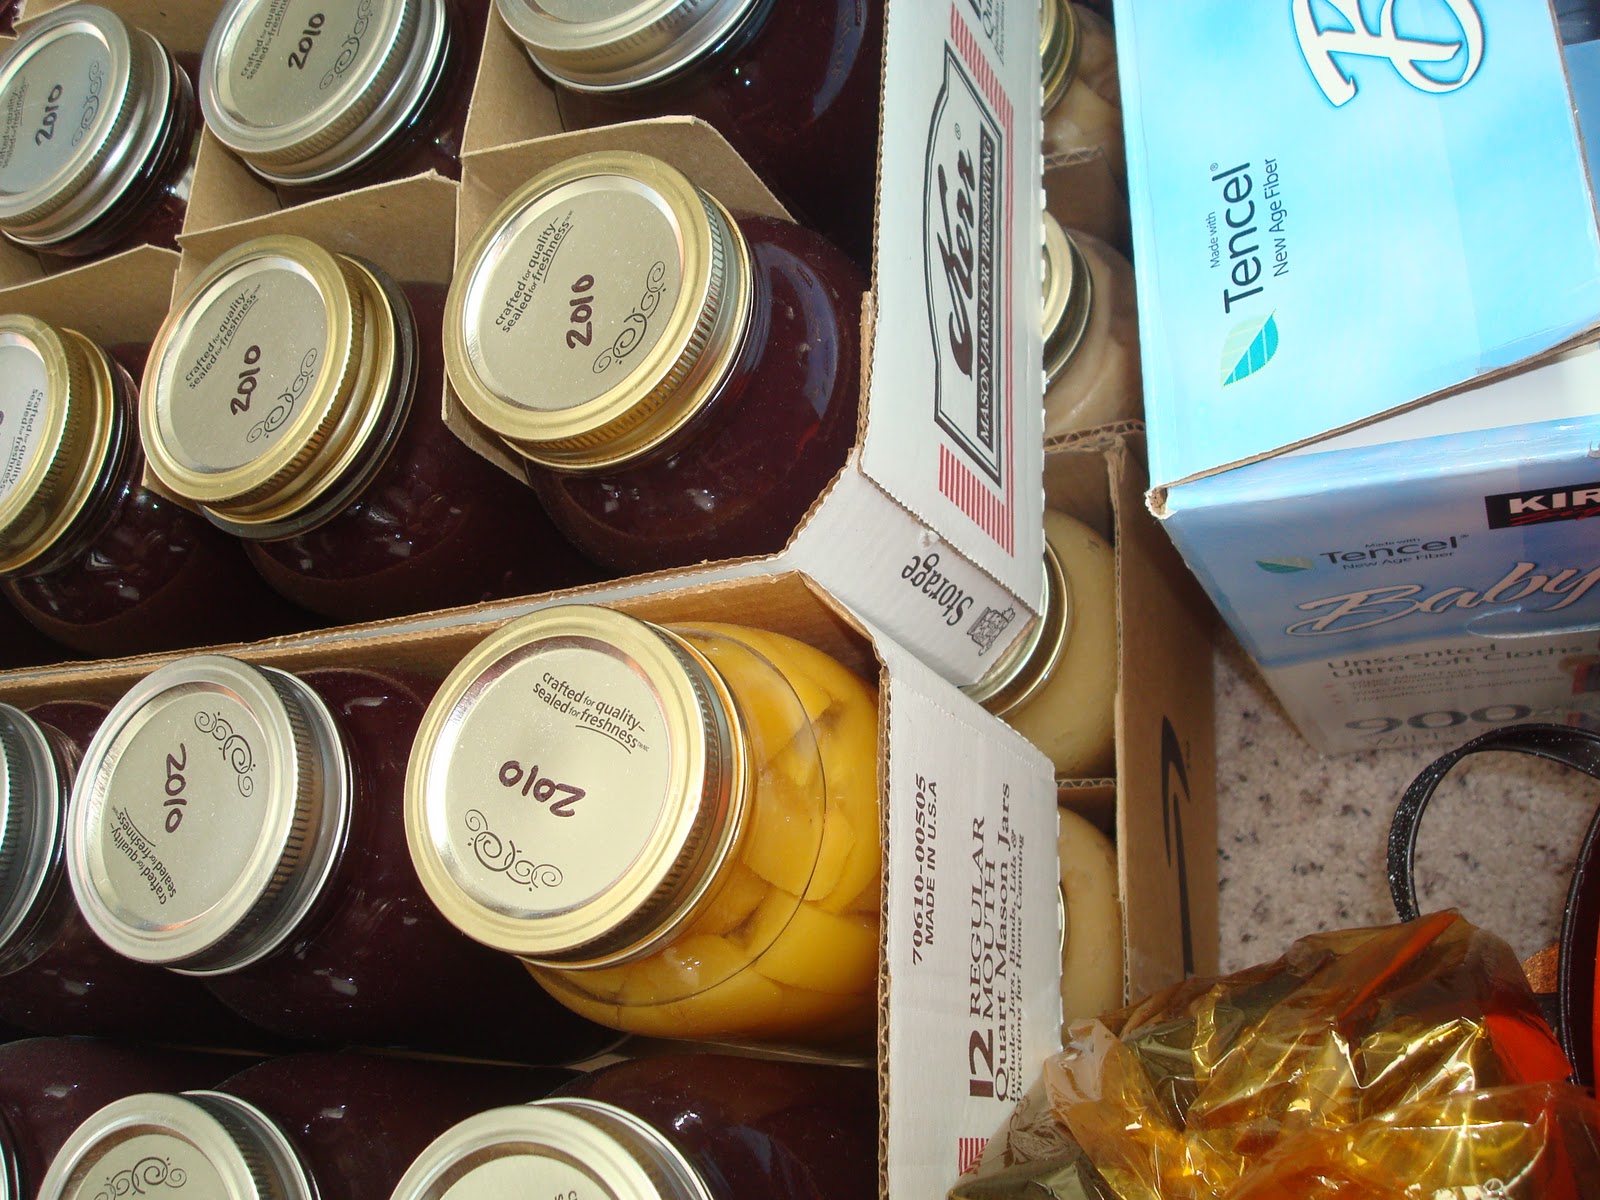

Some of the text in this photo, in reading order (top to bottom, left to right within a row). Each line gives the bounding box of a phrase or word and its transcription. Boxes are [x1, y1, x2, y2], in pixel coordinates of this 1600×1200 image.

[265, 0, 280, 28] quali
[268, 0, 288, 36] freshn
[288, 13, 325, 69] 2010
[35, 84, 63, 146] 2010
[1205, 211, 1220, 269] Made with
[1211, 162, 1264, 314] Tencel
[1263, 158, 1289, 277] New Age Fiber
[495, 280, 526, 326] crafted
[522, 270, 532, 282] for
[502, 220, 571, 333] sealed for freshness
[936, 148, 976, 381] Kerr
[979, 138, 993, 444] MASON JARS FOR PRESERVING
[189, 353, 217, 390] sealed
[219, 294, 257, 347] freshness
[566, 274, 595, 350] 2010
[185, 342, 215, 382] crafted
[230, 344, 262, 416] 2010
[1509, 487, 1600, 514] KIR
[1320, 535, 1458, 564] Tencel
[1343, 551, 1454, 570] New Age Fiber
[901, 553, 974, 627] Storage
[1285, 561, 1600, 636] Baby
[1327, 643, 1496, 670] Unscented
[1482, 646, 1583, 660] Cloths
[532, 682, 639, 749] sealed for freshness
[542, 671, 586, 703] crafted
[583, 696, 596, 708] for
[1345, 703, 1533, 736] 900
[163, 742, 188, 834] 2010
[498, 760, 587, 818] 2010
[116, 811, 177, 898] sealed for freshness
[136, 857, 144, 871] for
[140, 866, 167, 906] crafted
[912, 772, 926, 966] 70610-00505
[925, 781, 937, 946] MADE IN U.S.A
[1016, 833, 1025, 911] Canning
[970, 816, 985, 1018] REGULAR
[982, 857, 996, 1021] MOUTH
[995, 782, 1011, 1102] Quart Mason Jars
[1015, 975, 1023, 1002] for
[968, 1028, 994, 1098] 12
[1009, 1022, 1017, 1103] Includes
